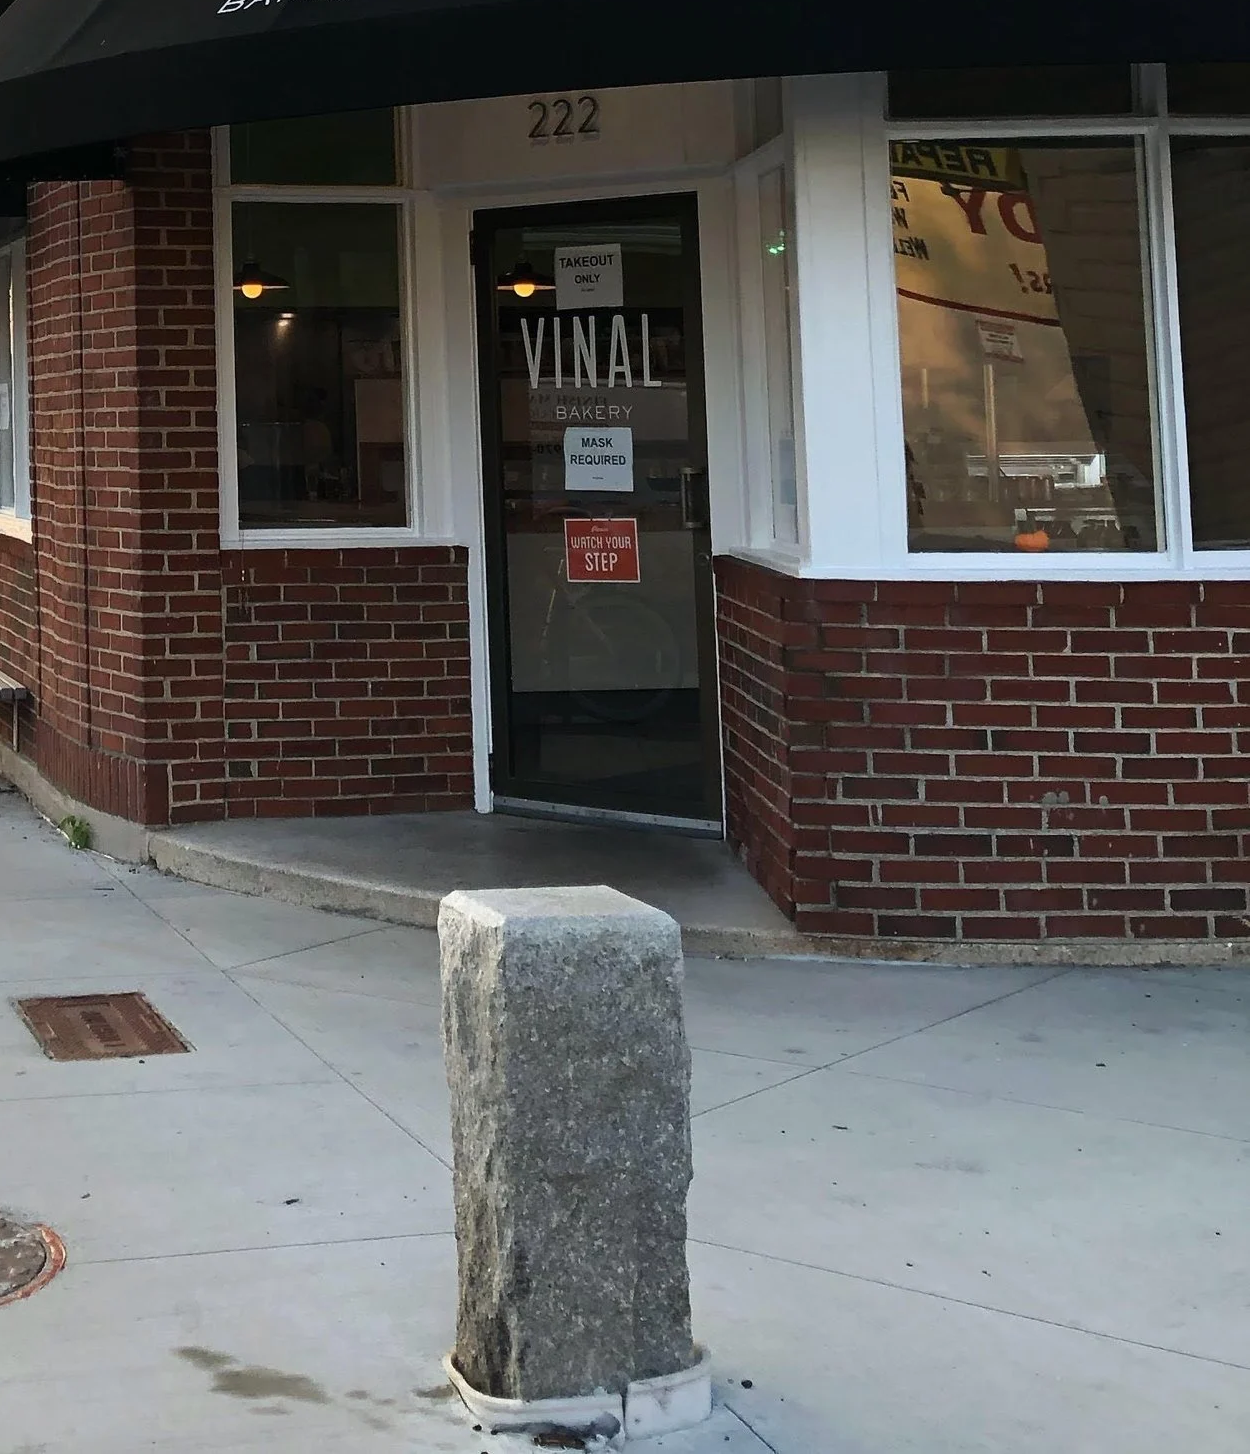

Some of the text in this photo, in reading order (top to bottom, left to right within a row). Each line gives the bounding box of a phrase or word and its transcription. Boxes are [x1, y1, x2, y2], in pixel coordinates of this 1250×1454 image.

[527, 96, 600, 139] 222
[559, 254, 614, 268] TAKEOUT
[574, 274, 601, 284] ONLY
[520, 313, 662, 389] VINAL
[556, 405, 633, 421] BAKERY
[581, 438, 613, 448] MASK
[570, 454, 626, 466] REQUIRED
[571, 536, 632, 549] WATCH YOUR
[585, 552, 618, 572] STEP
